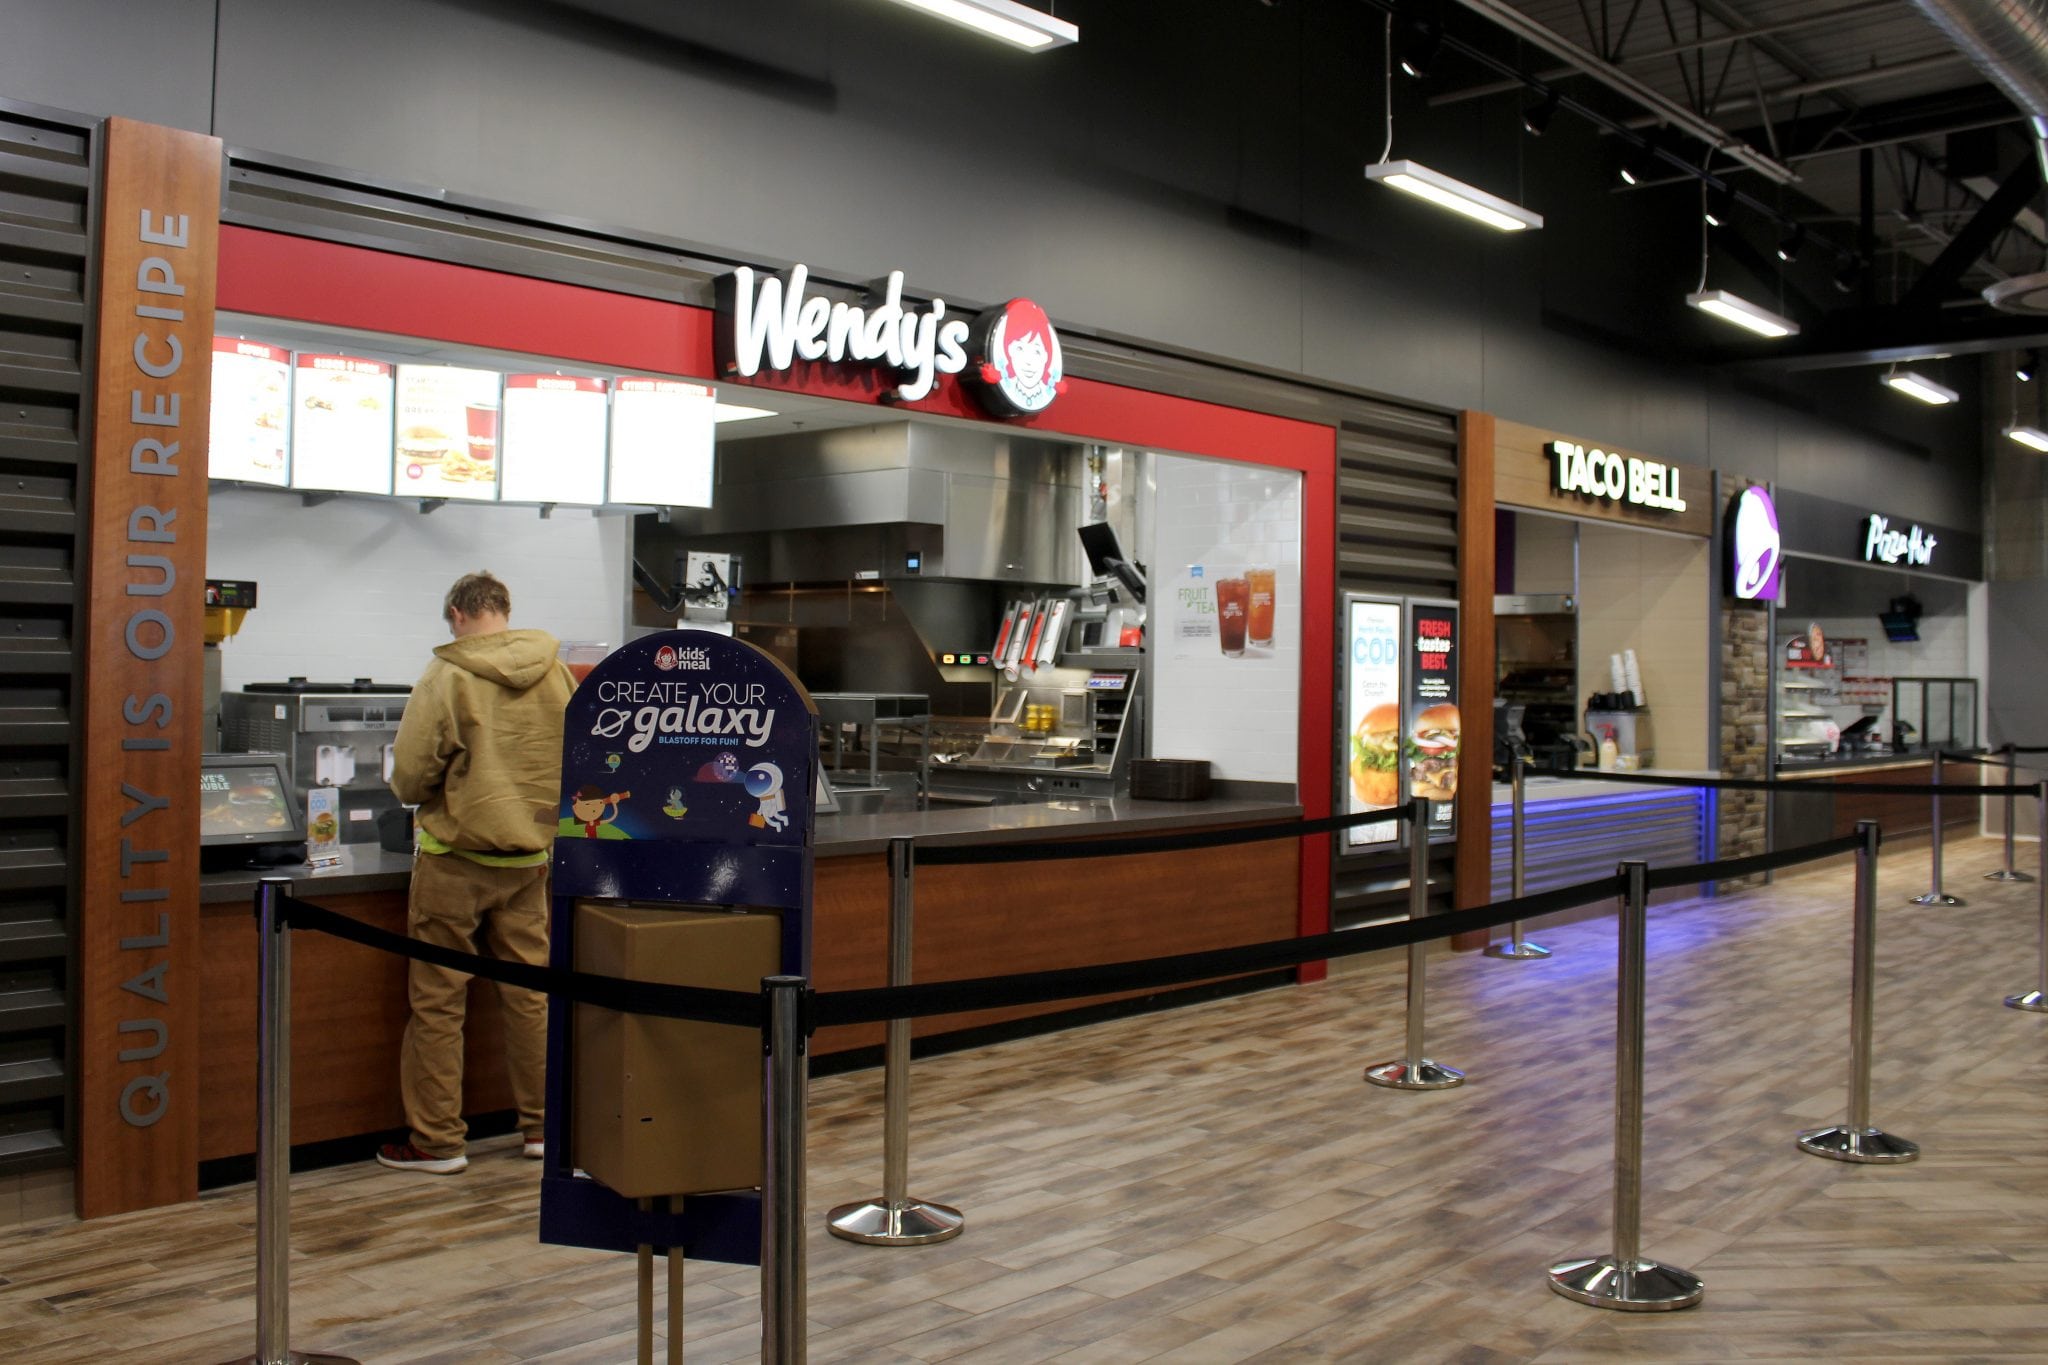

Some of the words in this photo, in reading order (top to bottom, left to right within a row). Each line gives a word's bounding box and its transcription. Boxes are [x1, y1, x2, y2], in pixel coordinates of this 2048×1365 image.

[130, 208, 189, 476] RECIPE
[735, 264, 969, 400] Wendy's
[1553, 440, 1626, 500] TACO
[1627, 457, 1687, 512] BELL
[1865, 513, 1908, 563] Pizza
[1907, 524, 1937, 565] Hut
[125, 504, 177, 661] OUR
[1178, 587, 1208, 600] FRUIT
[1196, 601, 1216, 614] TEA
[1354, 637, 1397, 664] COD
[1419, 619, 1451, 637] FRESH
[678, 658, 710, 670] meal
[598, 681, 687, 703] CREATE
[700, 683, 766, 705] YOUR
[122, 691, 173, 751] IS
[628, 695, 775, 753] galaxy
[659, 736, 699, 745] BLASTOFF
[700, 737, 718, 745] FOR
[719, 737, 739, 746] FUN!
[119, 782, 170, 1127] QUALITY
